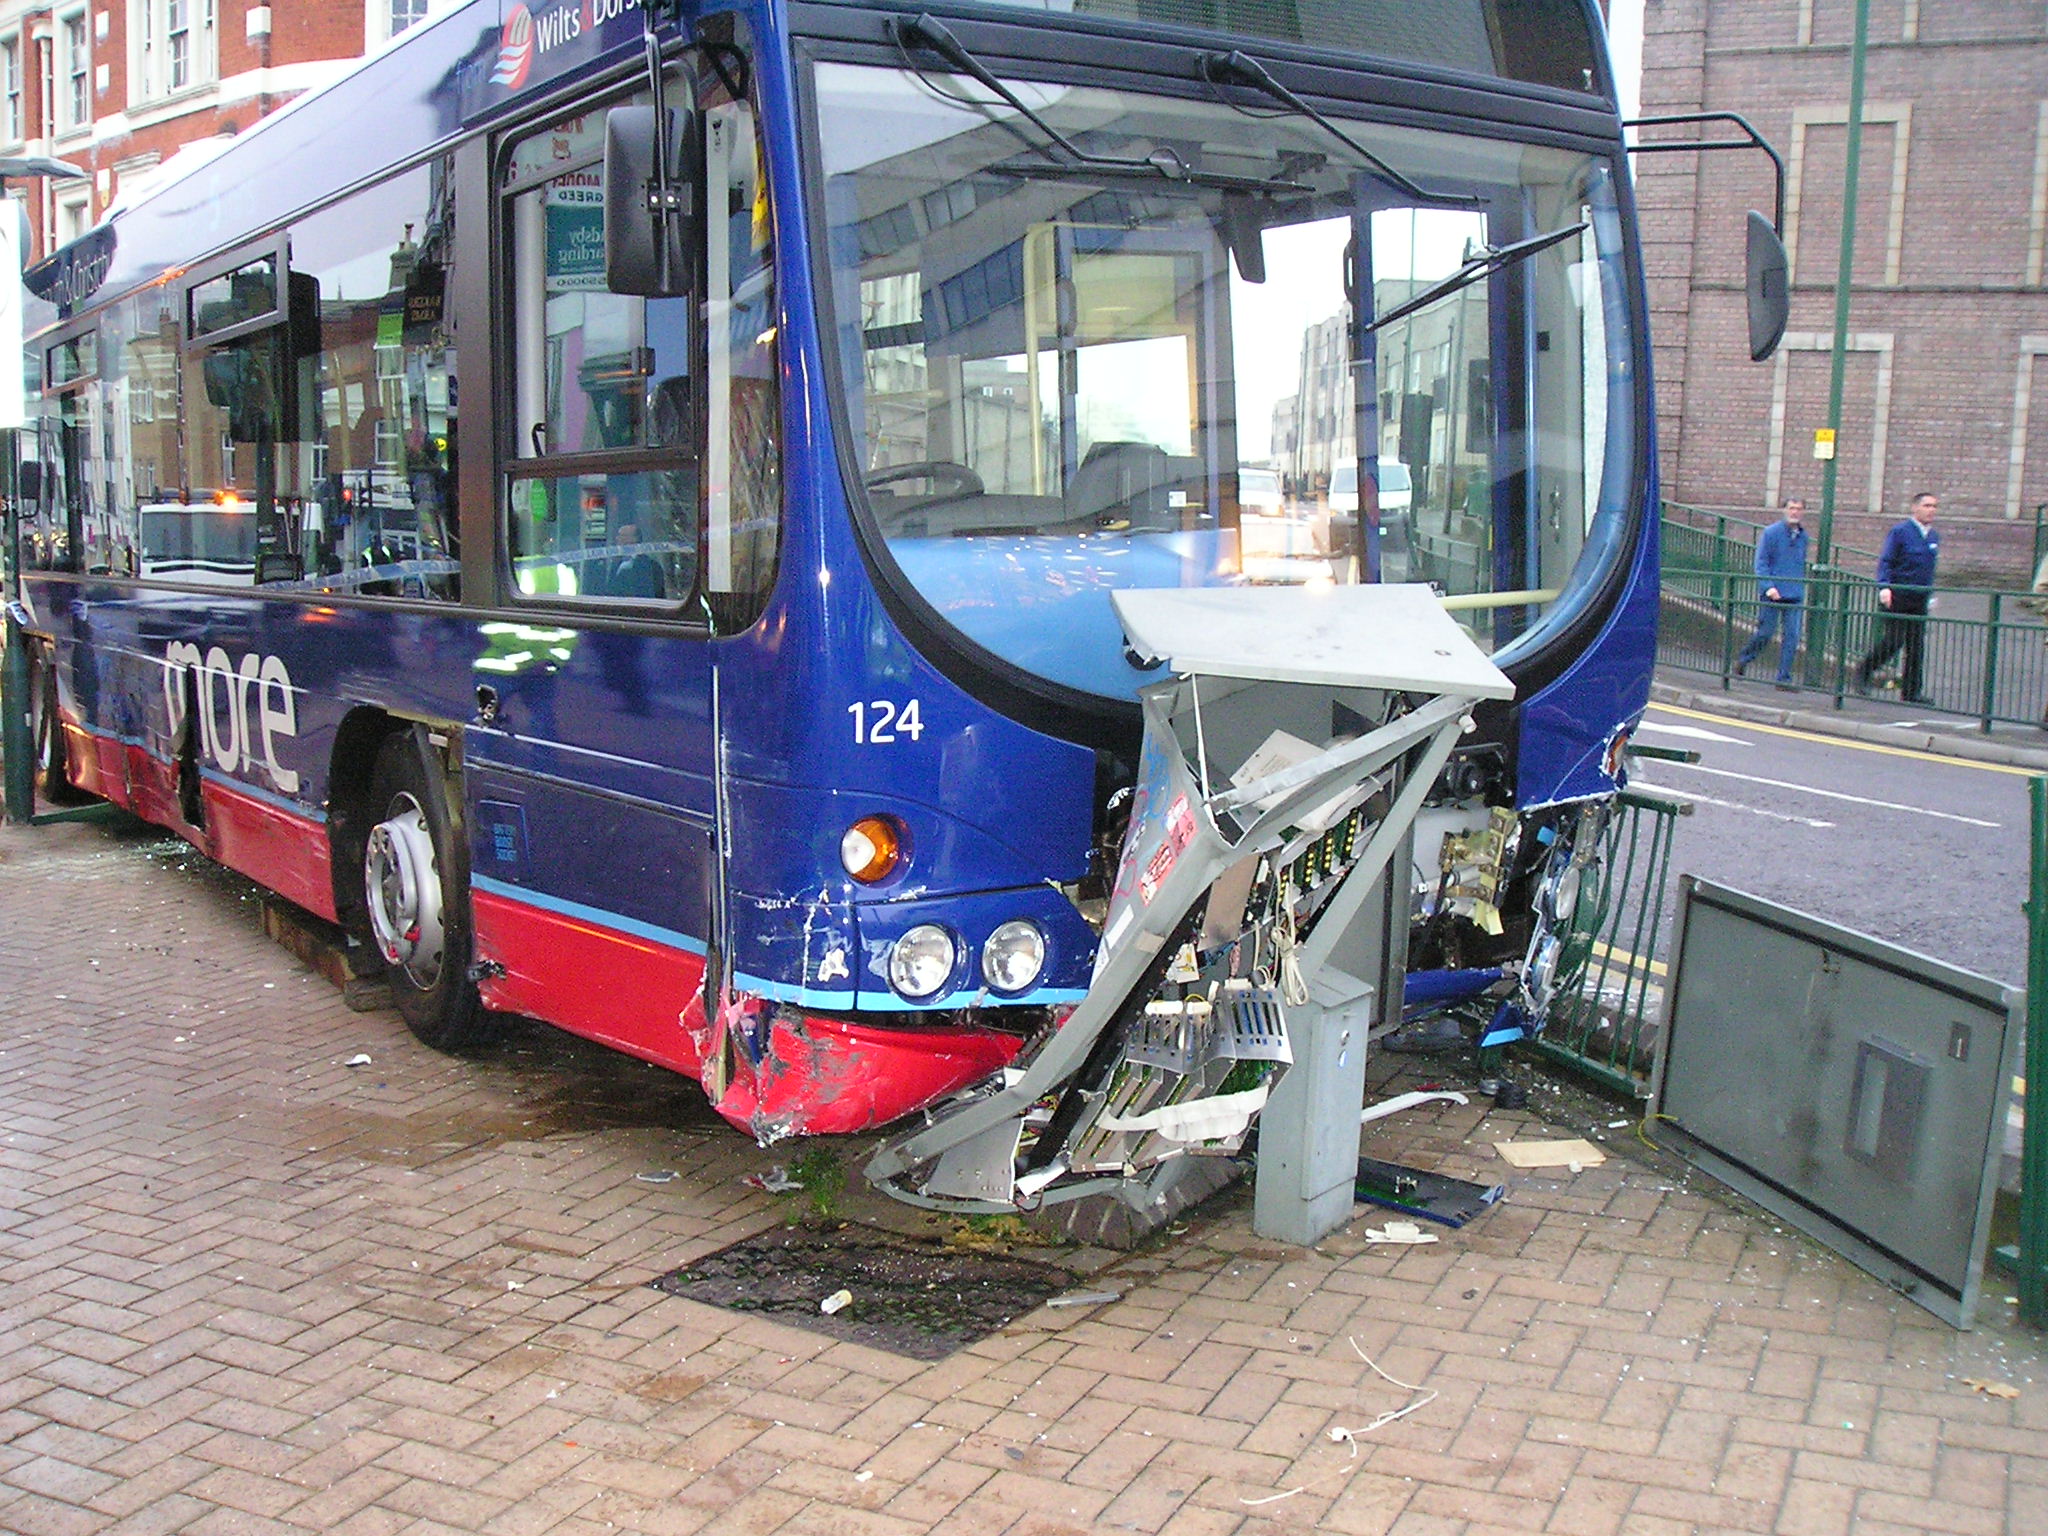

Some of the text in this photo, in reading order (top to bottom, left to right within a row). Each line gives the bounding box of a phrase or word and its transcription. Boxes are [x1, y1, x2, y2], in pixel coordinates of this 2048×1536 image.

[537, 6, 580, 53] Wilts
[163, 640, 299, 793] more
[847, 699, 925, 744] 124
